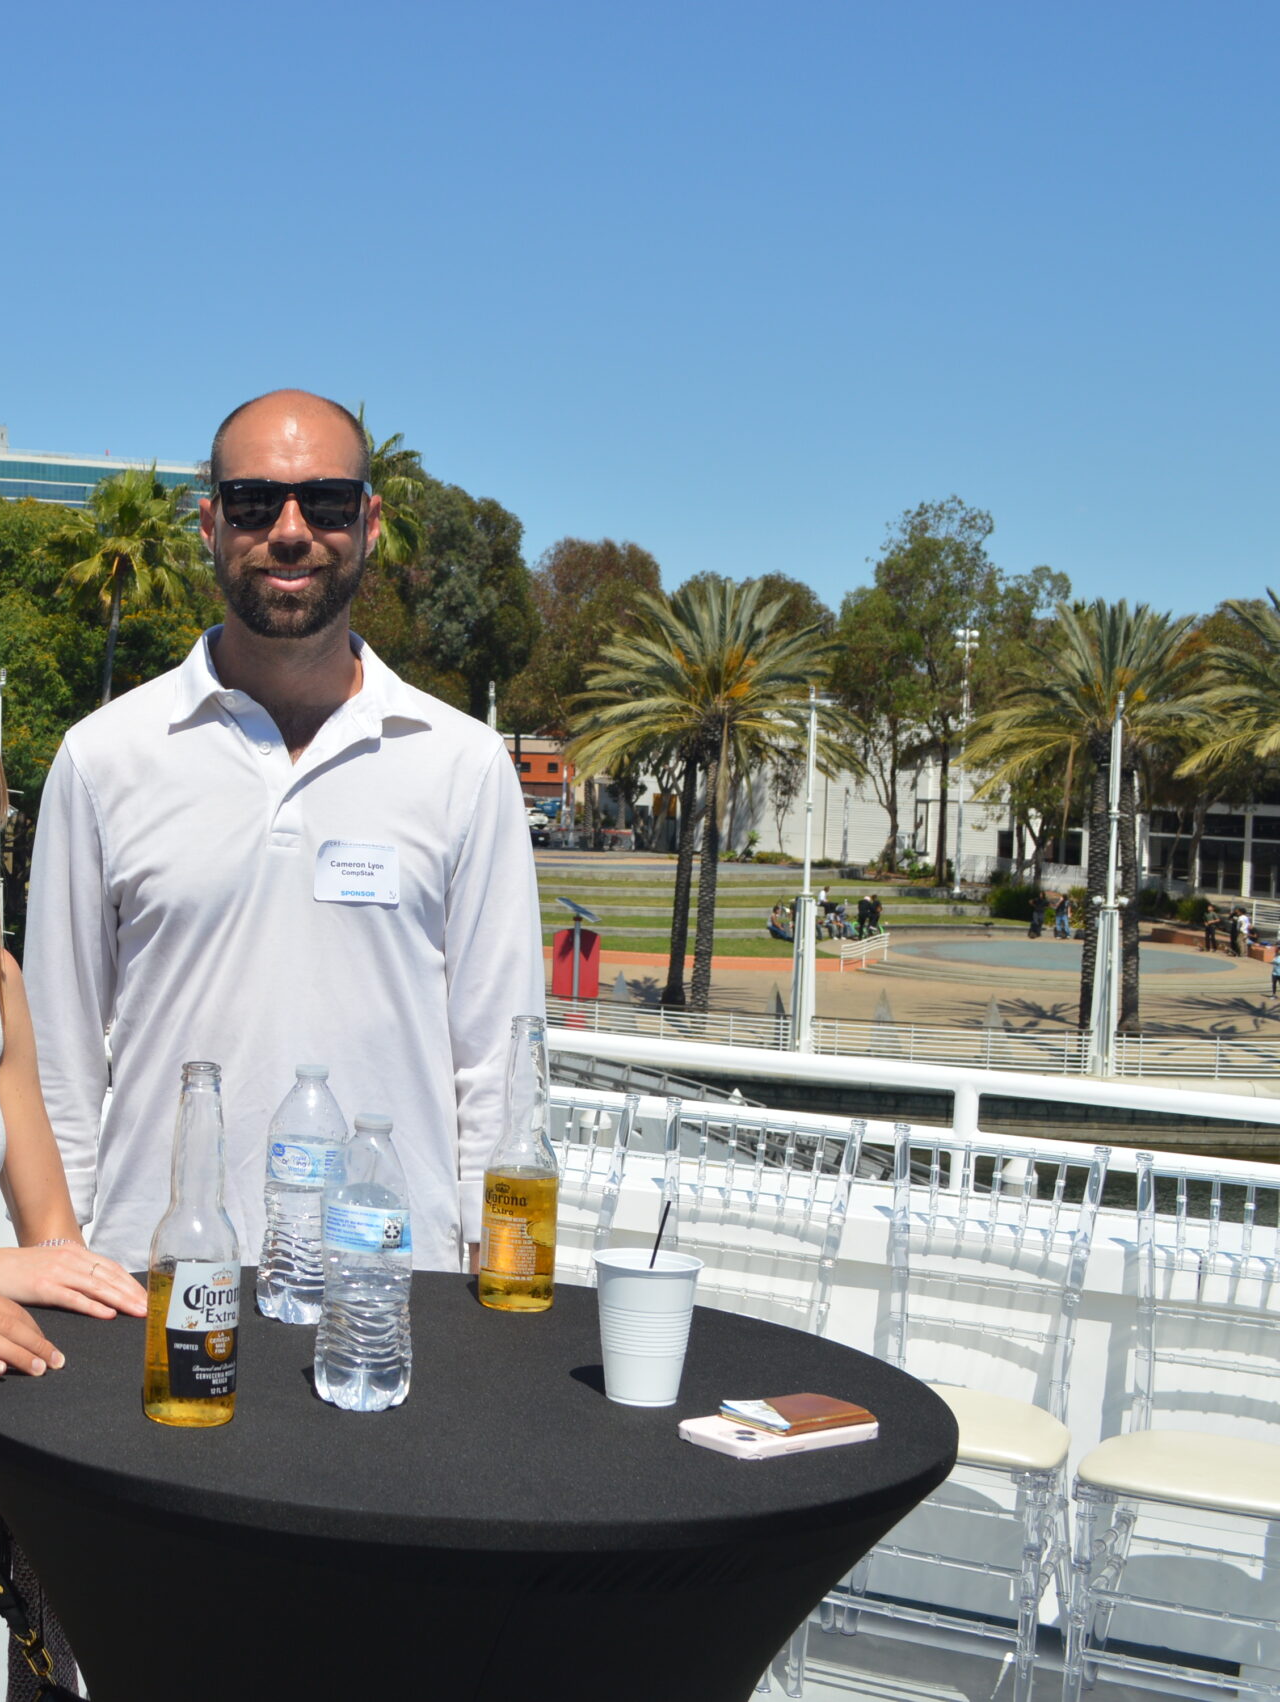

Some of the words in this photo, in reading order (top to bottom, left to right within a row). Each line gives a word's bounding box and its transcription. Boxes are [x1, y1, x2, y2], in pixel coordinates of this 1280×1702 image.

[330, 860, 366, 868] Cameron
[367, 862, 384, 871] Lyon
[341, 869, 375, 877] CompStak
[485, 1188, 528, 1207] Corona
[491, 1203, 514, 1216] Extra
[183, 1284, 239, 1314] Coron
[205, 1308, 236, 1323] Extra
[173, 1342, 199, 1351] IMPORTED
